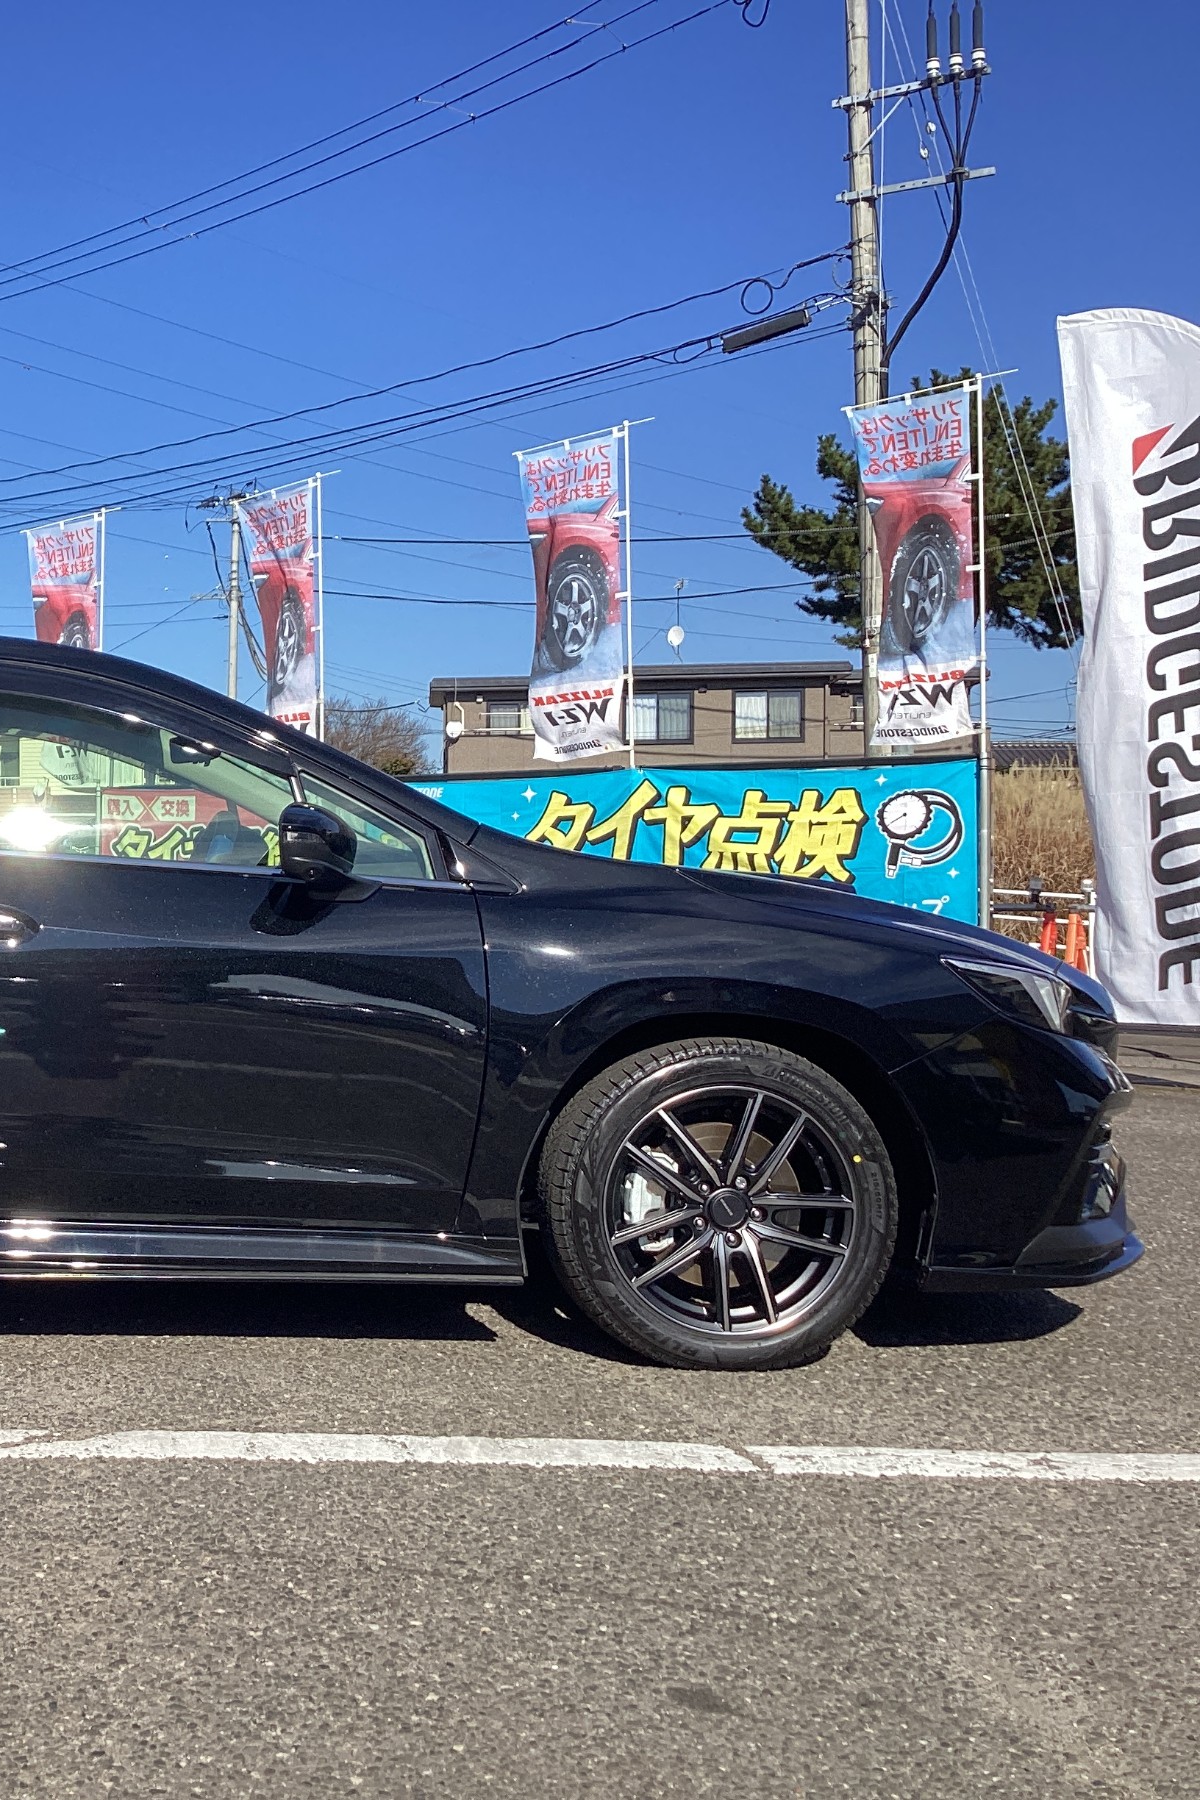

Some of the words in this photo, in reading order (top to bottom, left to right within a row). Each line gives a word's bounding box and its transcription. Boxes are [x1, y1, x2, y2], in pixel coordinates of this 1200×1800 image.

[160, 799, 190, 818] 交換
[525, 778, 867, 884] タイヤ点検
